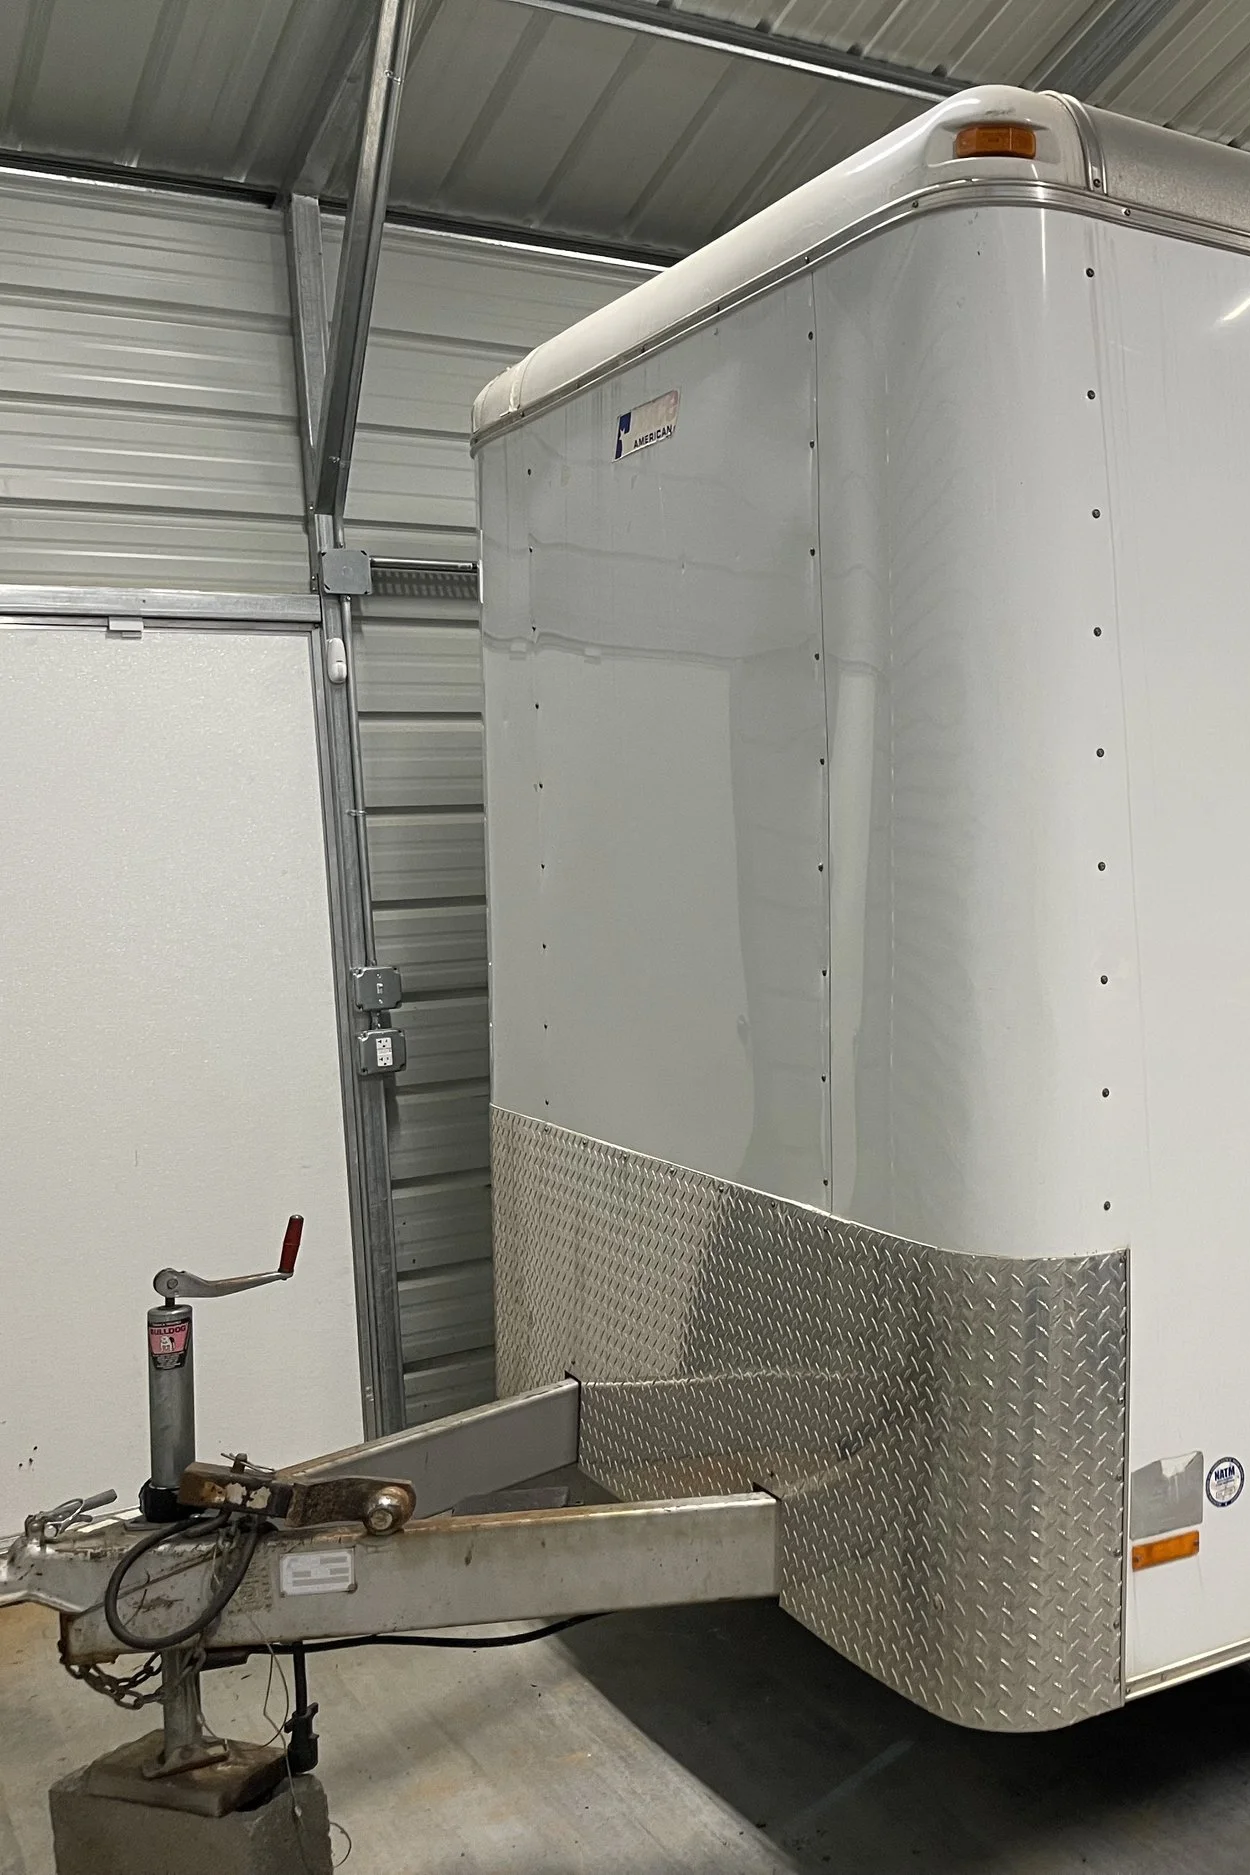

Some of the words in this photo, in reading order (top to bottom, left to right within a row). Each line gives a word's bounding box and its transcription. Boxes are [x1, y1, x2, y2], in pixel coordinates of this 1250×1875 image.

[634, 424, 672, 449] AMERICAN
[150, 1325, 186, 1335] BULLDOG
[1214, 1465, 1235, 1481] NATM
